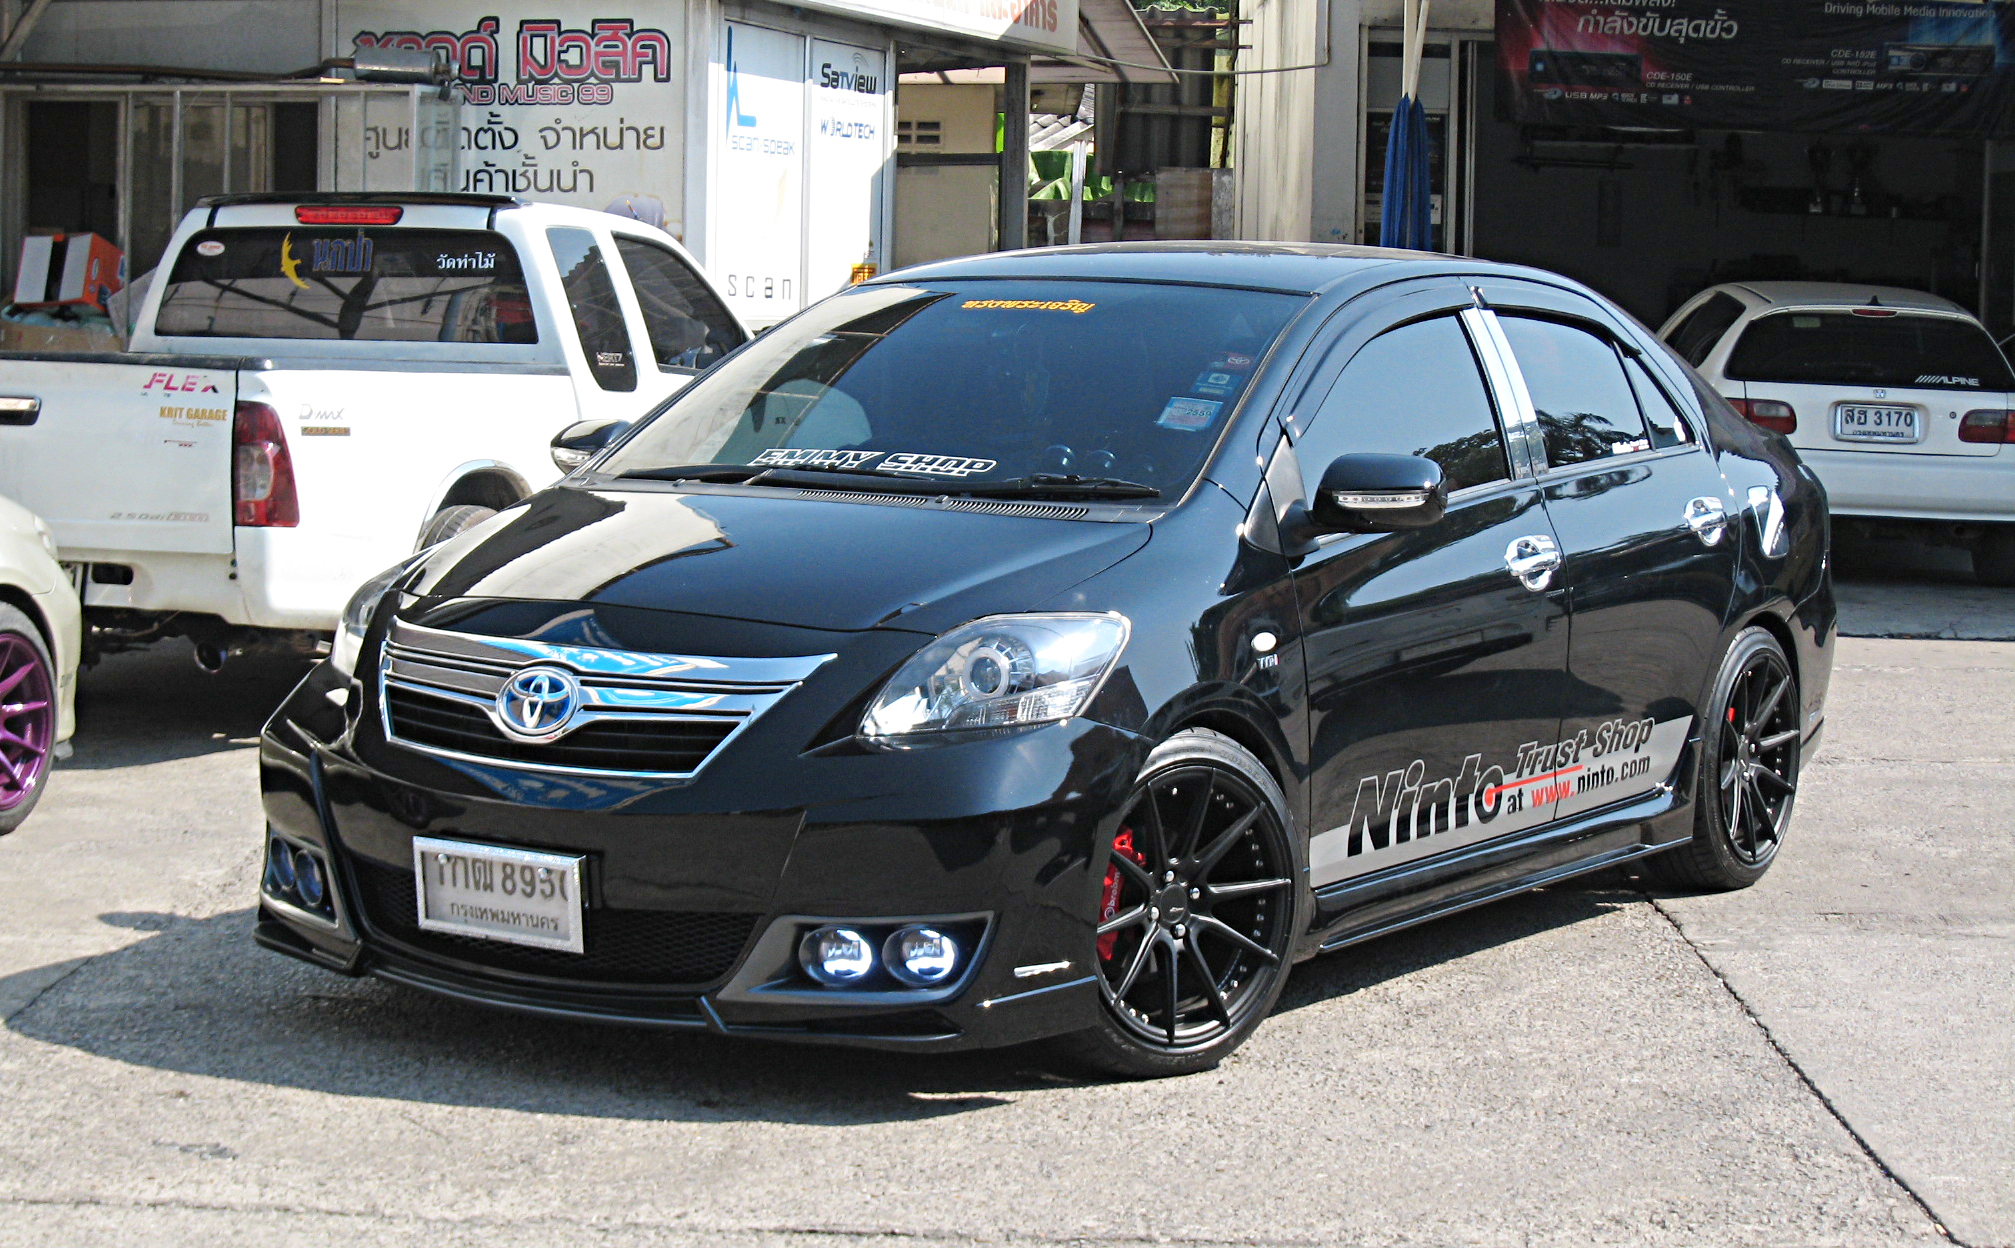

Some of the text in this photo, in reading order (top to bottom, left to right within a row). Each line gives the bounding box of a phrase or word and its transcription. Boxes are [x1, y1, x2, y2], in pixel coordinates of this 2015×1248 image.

[1824, 2, 1997, 18] Driving Mobile Media Innovation
[498, 83, 574, 105] MUSIC
[577, 83, 613, 105] 99
[538, 117, 666, 151] จำหน่าย
[436, 251, 496, 270] วัดท่าไม้
[1936, 375, 1980, 387] ALPINE
[159, 406, 228, 421] KRIT GARAGE
[1874, 410, 1913, 427] 3170
[876, 452, 998, 477] SHOP
[1515, 717, 1655, 779] Trust Shop
[1507, 754, 1651, 815] at www.ninto.com
[1347, 753, 1505, 858] Ninto
[451, 902, 560, 931] กรุงเทพมหานคร
